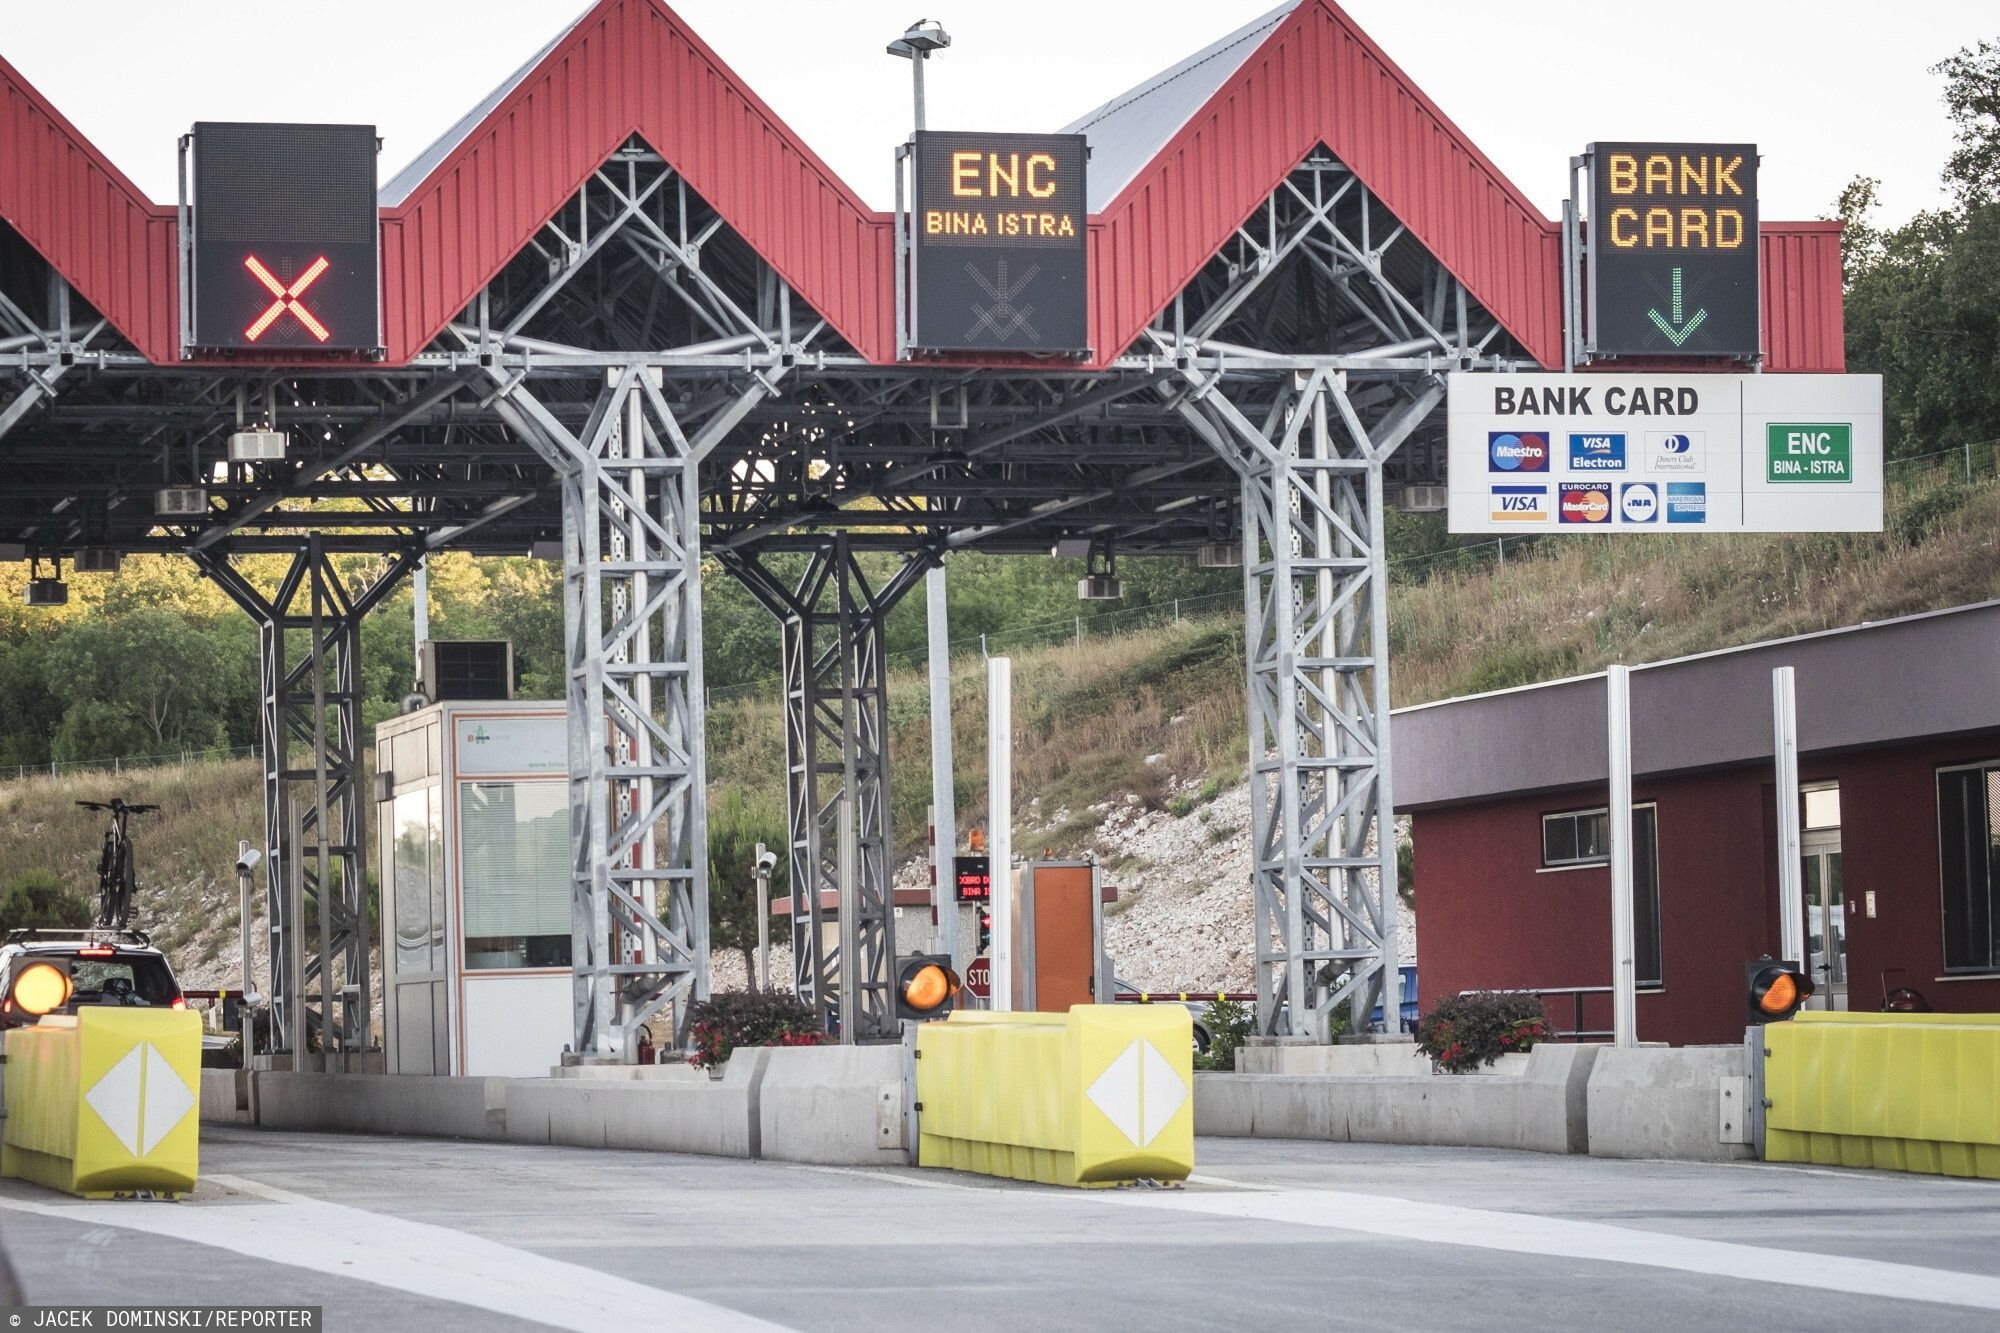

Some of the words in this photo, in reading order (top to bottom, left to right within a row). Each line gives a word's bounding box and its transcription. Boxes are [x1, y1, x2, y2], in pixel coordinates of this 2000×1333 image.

[953, 152, 1055, 198] ENC
[1610, 154, 1743, 195] BANK
[926, 211, 988, 235] BINA
[998, 212, 1075, 237] ISTRA
[1611, 207, 1743, 248] CARD
[1494, 386, 1593, 416] BANK
[1604, 386, 1699, 416] CARD
[1582, 437, 1611, 448] VISA
[1788, 432, 1831, 455] ENC
[1496, 446, 1543, 458] Maestro
[1573, 457, 1623, 468] Electron
[1774, 460, 1802, 474] BINA
[1810, 460, 1845, 474] ISTRA
[1501, 496, 1538, 511] VISA
[1562, 502, 1608, 511] MasterCard
[969, 969, 990, 985] STO
